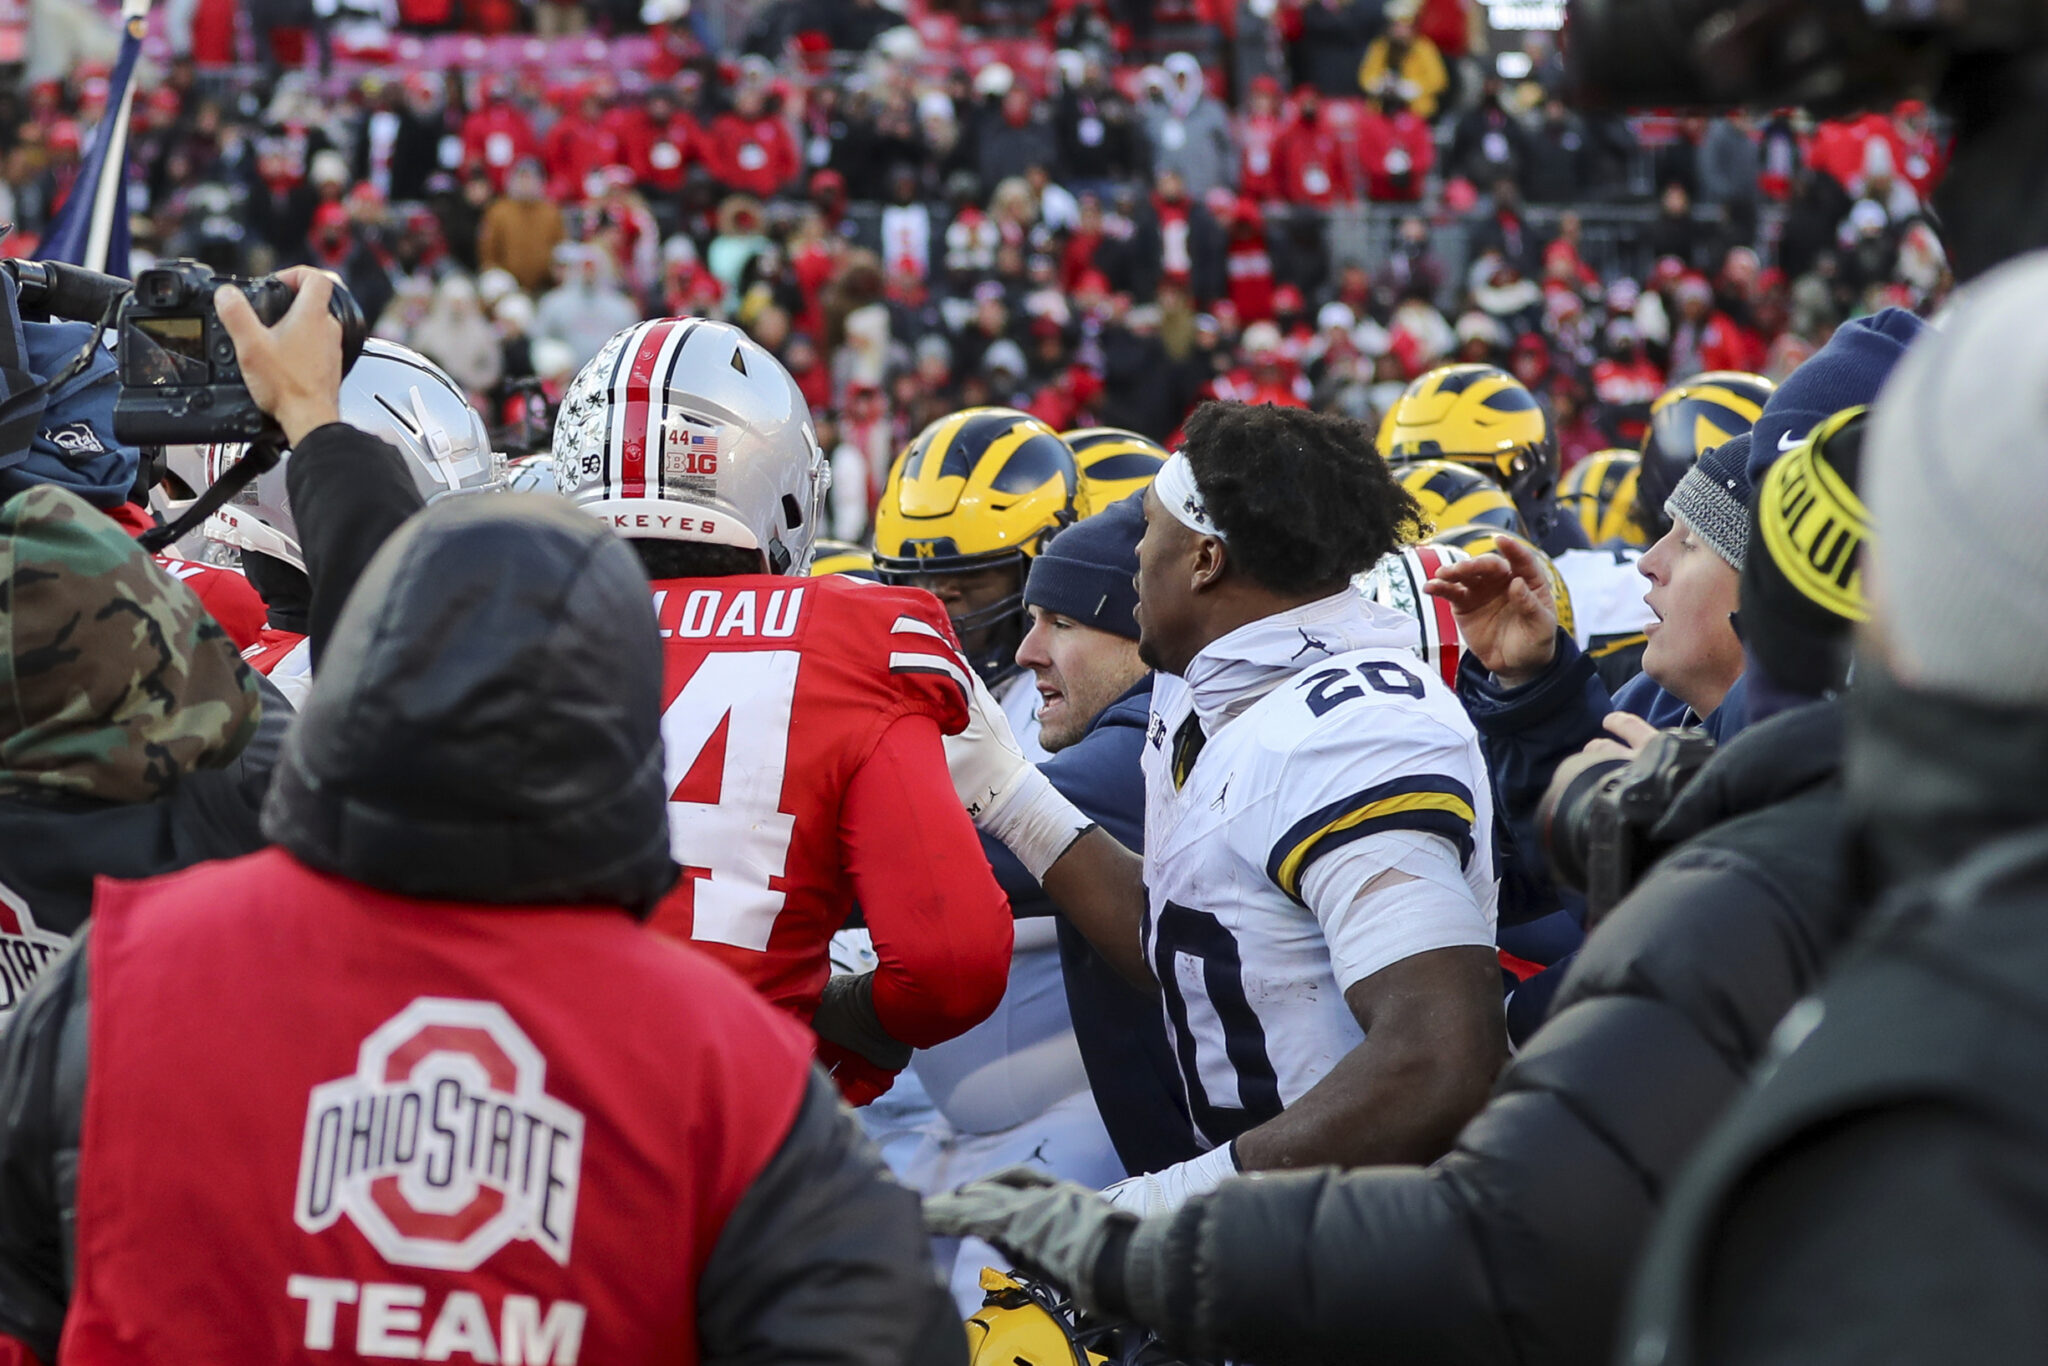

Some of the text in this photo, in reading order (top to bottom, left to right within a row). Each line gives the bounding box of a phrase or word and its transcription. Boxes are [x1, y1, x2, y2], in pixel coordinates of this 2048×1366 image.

[669, 430, 689, 446] 44
[914, 541, 936, 559] M
[1295, 661, 1426, 718] 20
[966, 802, 981, 817] M
[1143, 887, 1285, 1152] 0
[286, 1272, 588, 1366] TEAM
